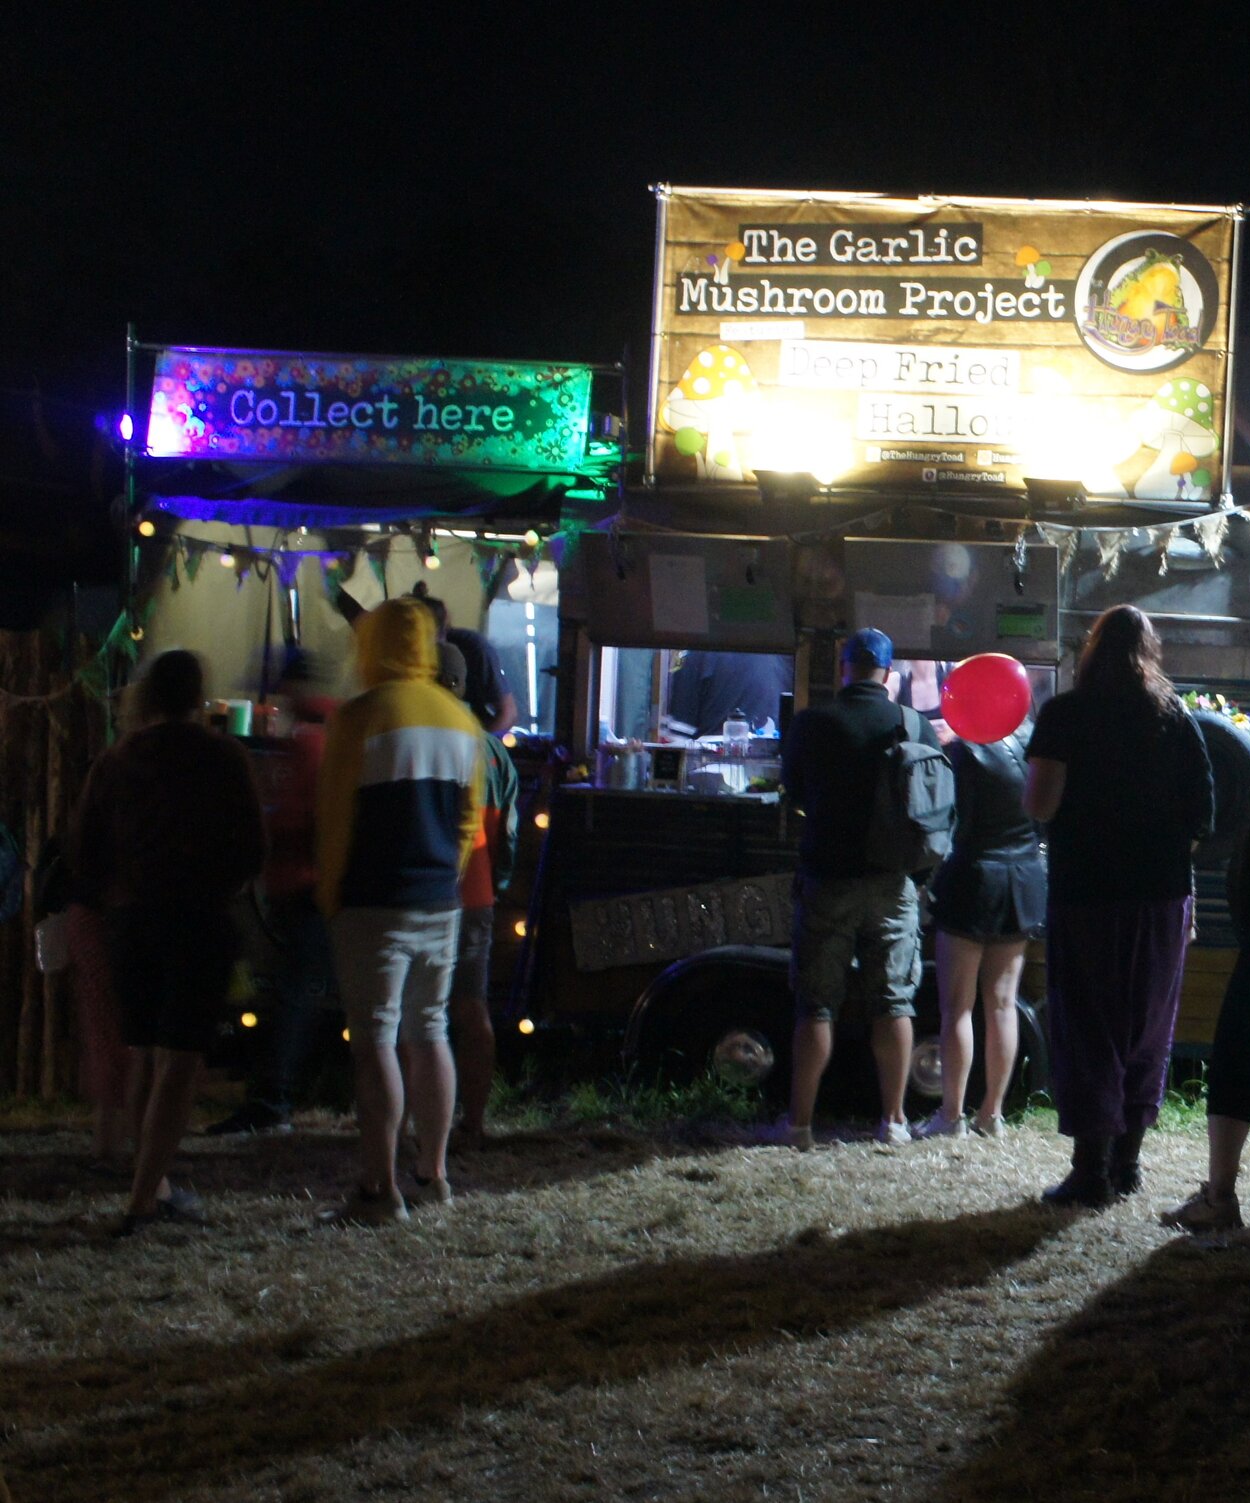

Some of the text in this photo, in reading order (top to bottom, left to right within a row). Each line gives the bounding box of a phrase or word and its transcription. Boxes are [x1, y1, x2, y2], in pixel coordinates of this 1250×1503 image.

[742, 228, 978, 265] The Garlic
[679, 277, 1065, 324] Mushroom Project
[786, 344, 1013, 388] Deep Fried
[229, 390, 515, 433] Collect here
